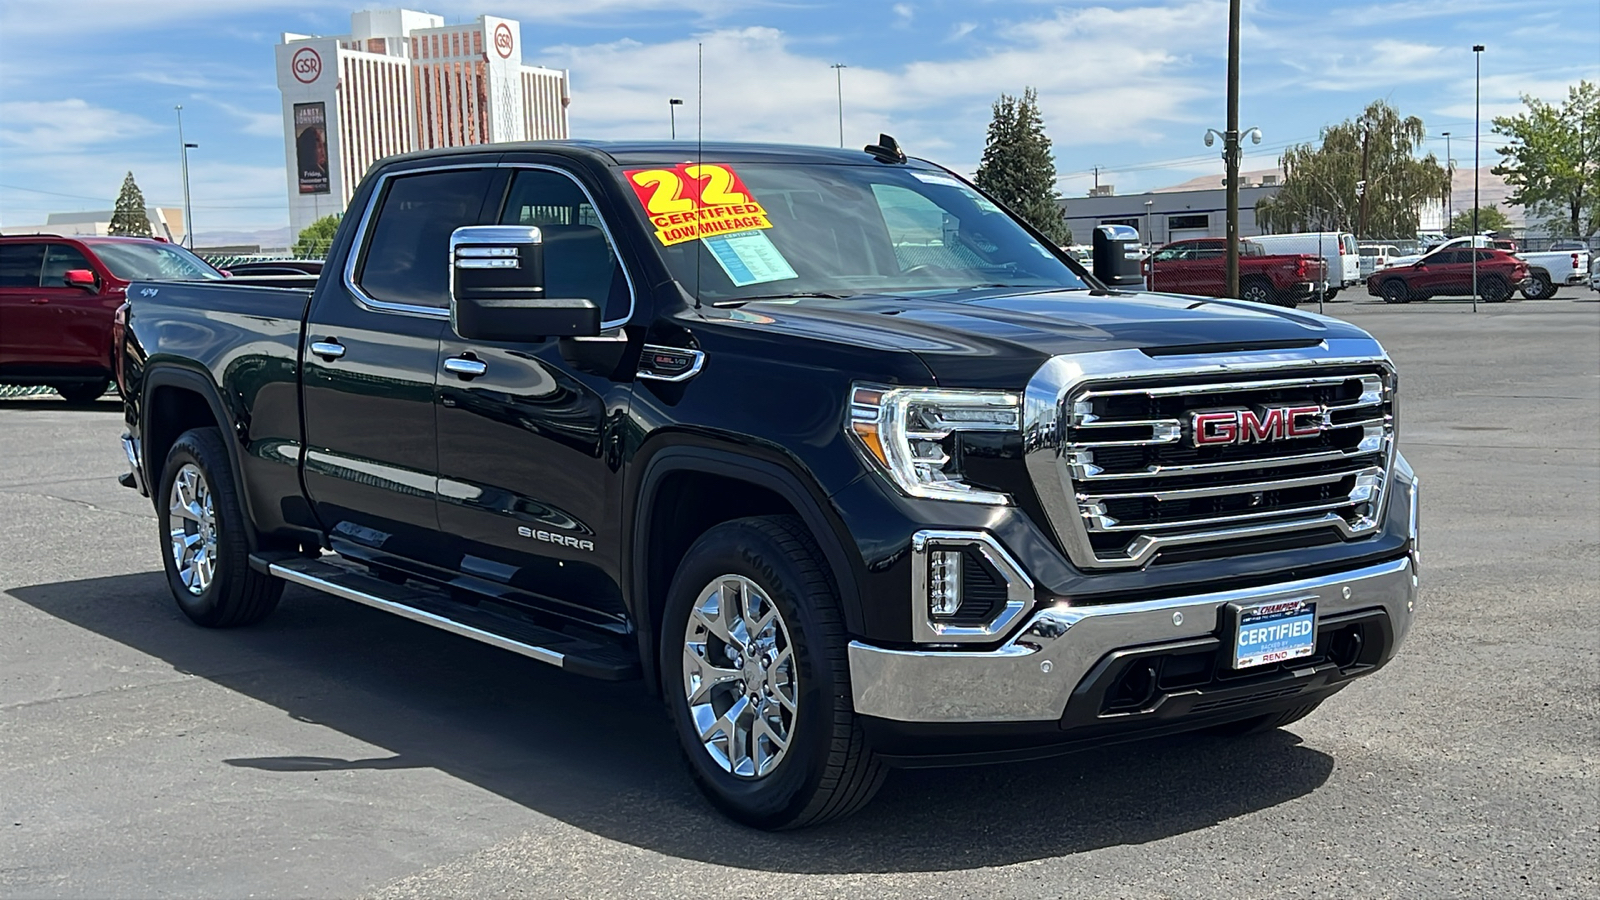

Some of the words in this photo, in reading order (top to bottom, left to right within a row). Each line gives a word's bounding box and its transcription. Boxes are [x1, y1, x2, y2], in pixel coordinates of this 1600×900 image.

[496, 33, 511, 49] GSR
[295, 57, 318, 74] GSR
[654, 203, 760, 228] CERTIFIED
[663, 225, 696, 242] LOW
[699, 215, 763, 235] MILEAGE
[1192, 405, 1321, 447] GMC
[517, 525, 595, 552] SIERRA
[1260, 600, 1301, 613] CHAMPION
[1238, 620, 1313, 647] CERTIFIED
[1262, 651, 1288, 662] RENO
